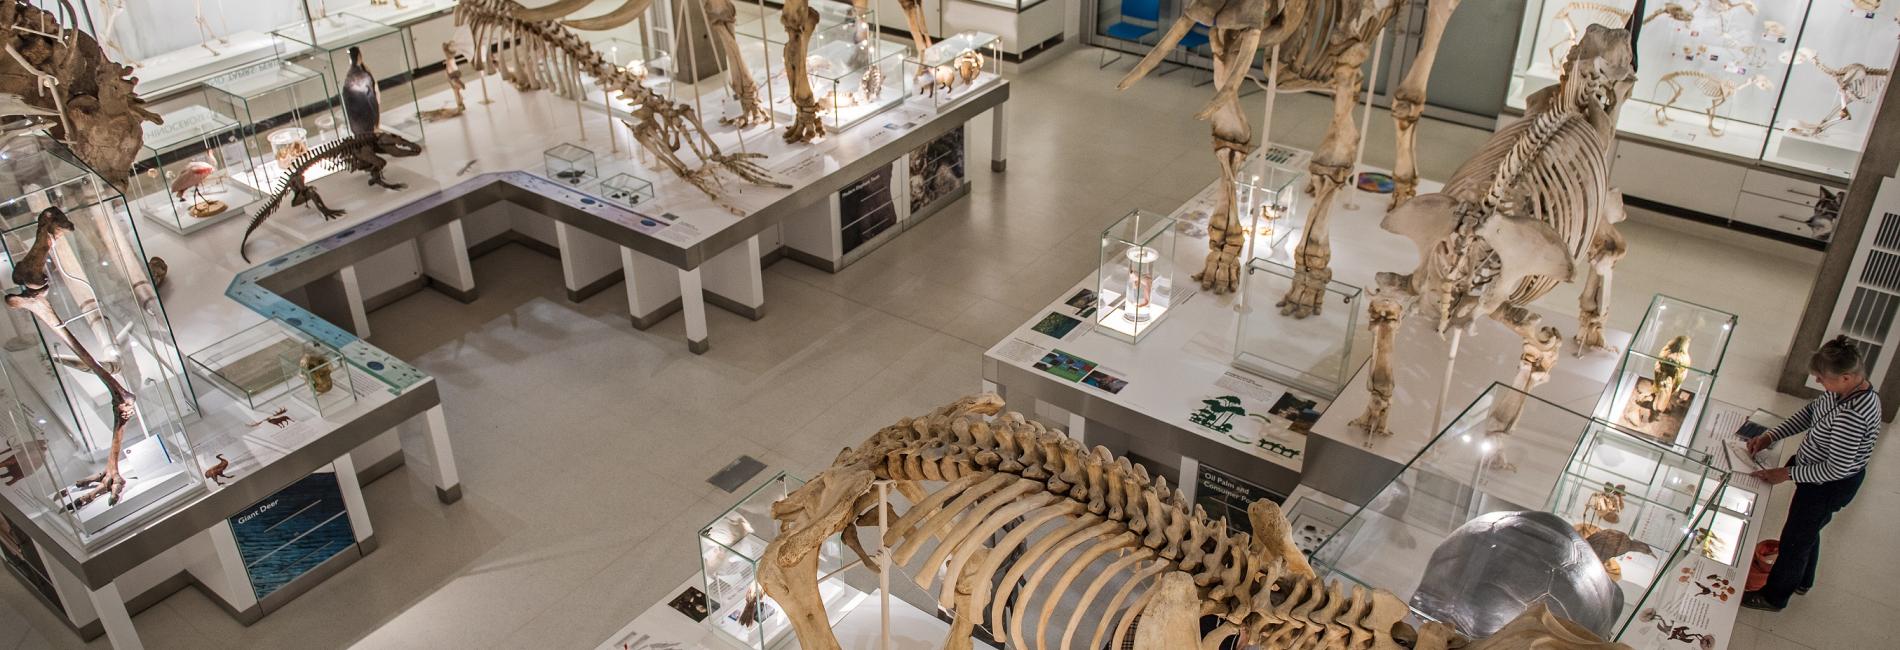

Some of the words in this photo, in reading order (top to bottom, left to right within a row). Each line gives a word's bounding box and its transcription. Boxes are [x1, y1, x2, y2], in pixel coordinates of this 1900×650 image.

[1203, 480, 1241, 499] Consumer
[1241, 495, 1252, 504] Po
[1205, 472, 1215, 480] Oil
[1217, 477, 1235, 489] Palm
[1236, 486, 1250, 495] and
[238, 510, 259, 524] Giant
[259, 499, 279, 513] Deer
